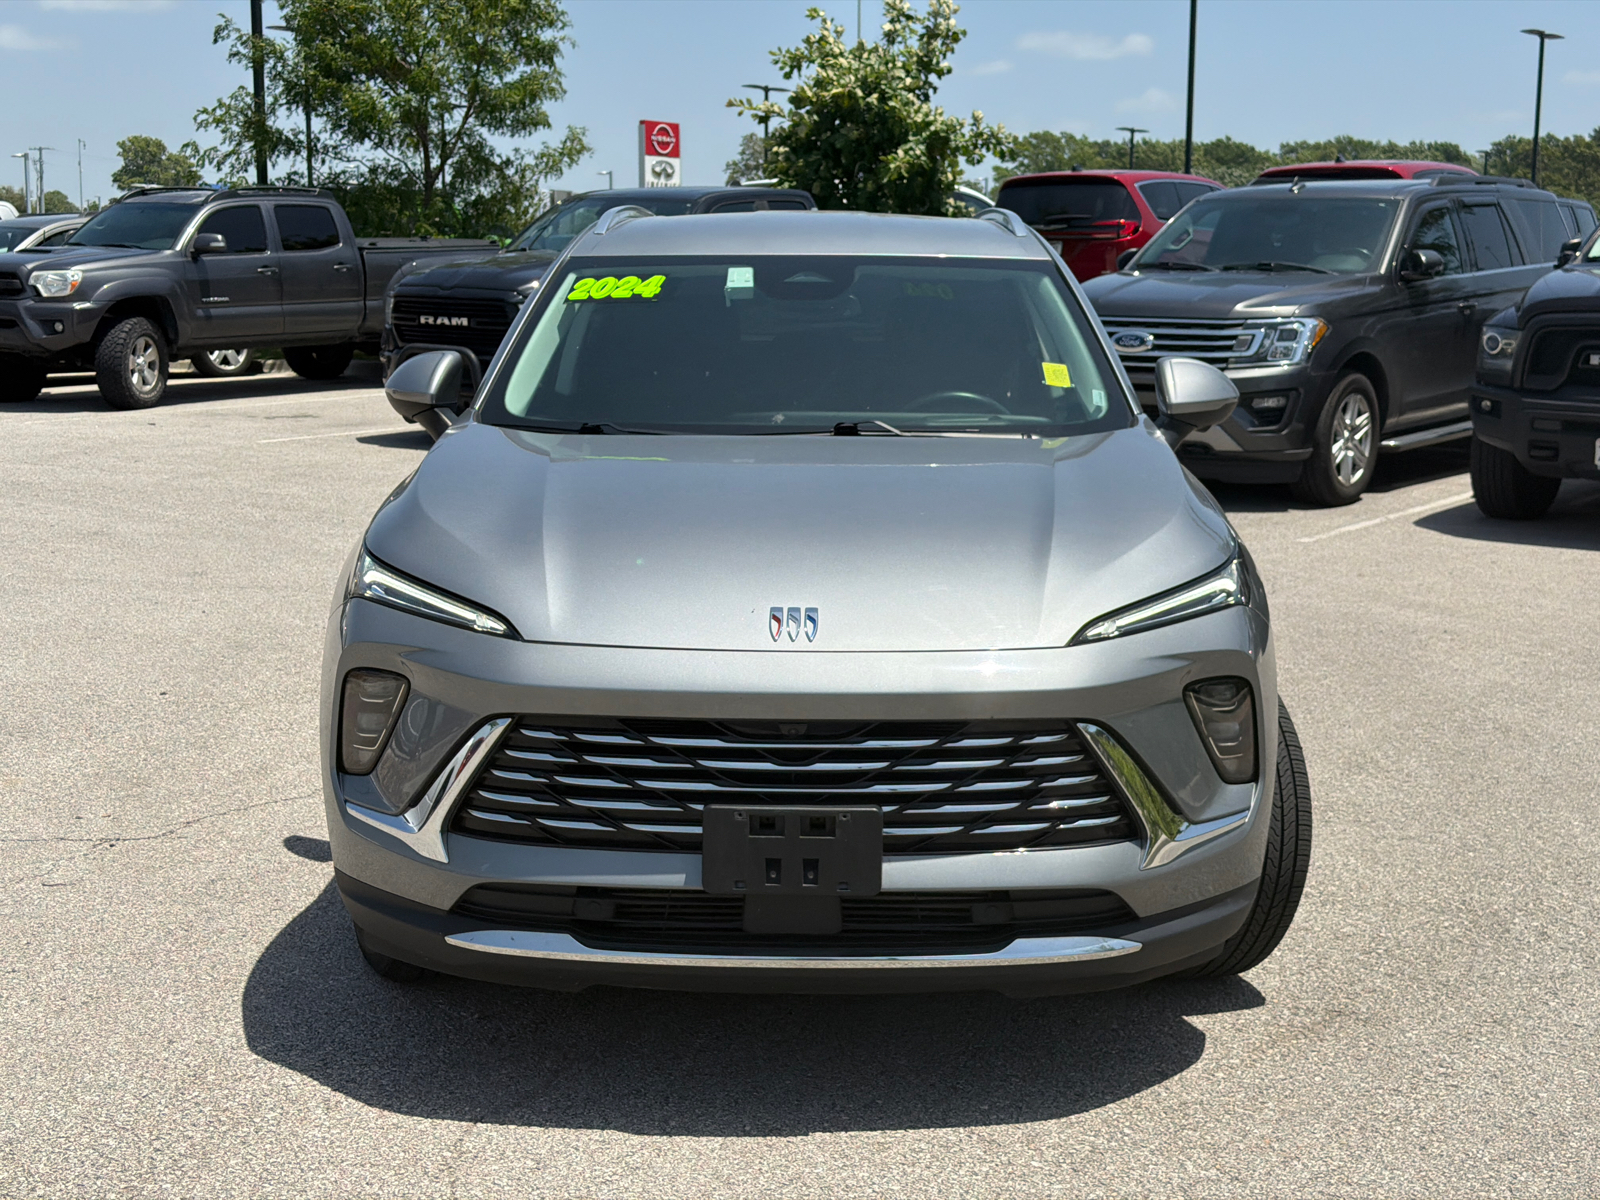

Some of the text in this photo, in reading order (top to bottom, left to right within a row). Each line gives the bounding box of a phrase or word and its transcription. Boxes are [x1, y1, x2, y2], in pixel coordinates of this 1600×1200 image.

[567, 275, 666, 300] 2024
[420, 315, 468, 327] RAM
[1119, 335, 1140, 346] Ford
